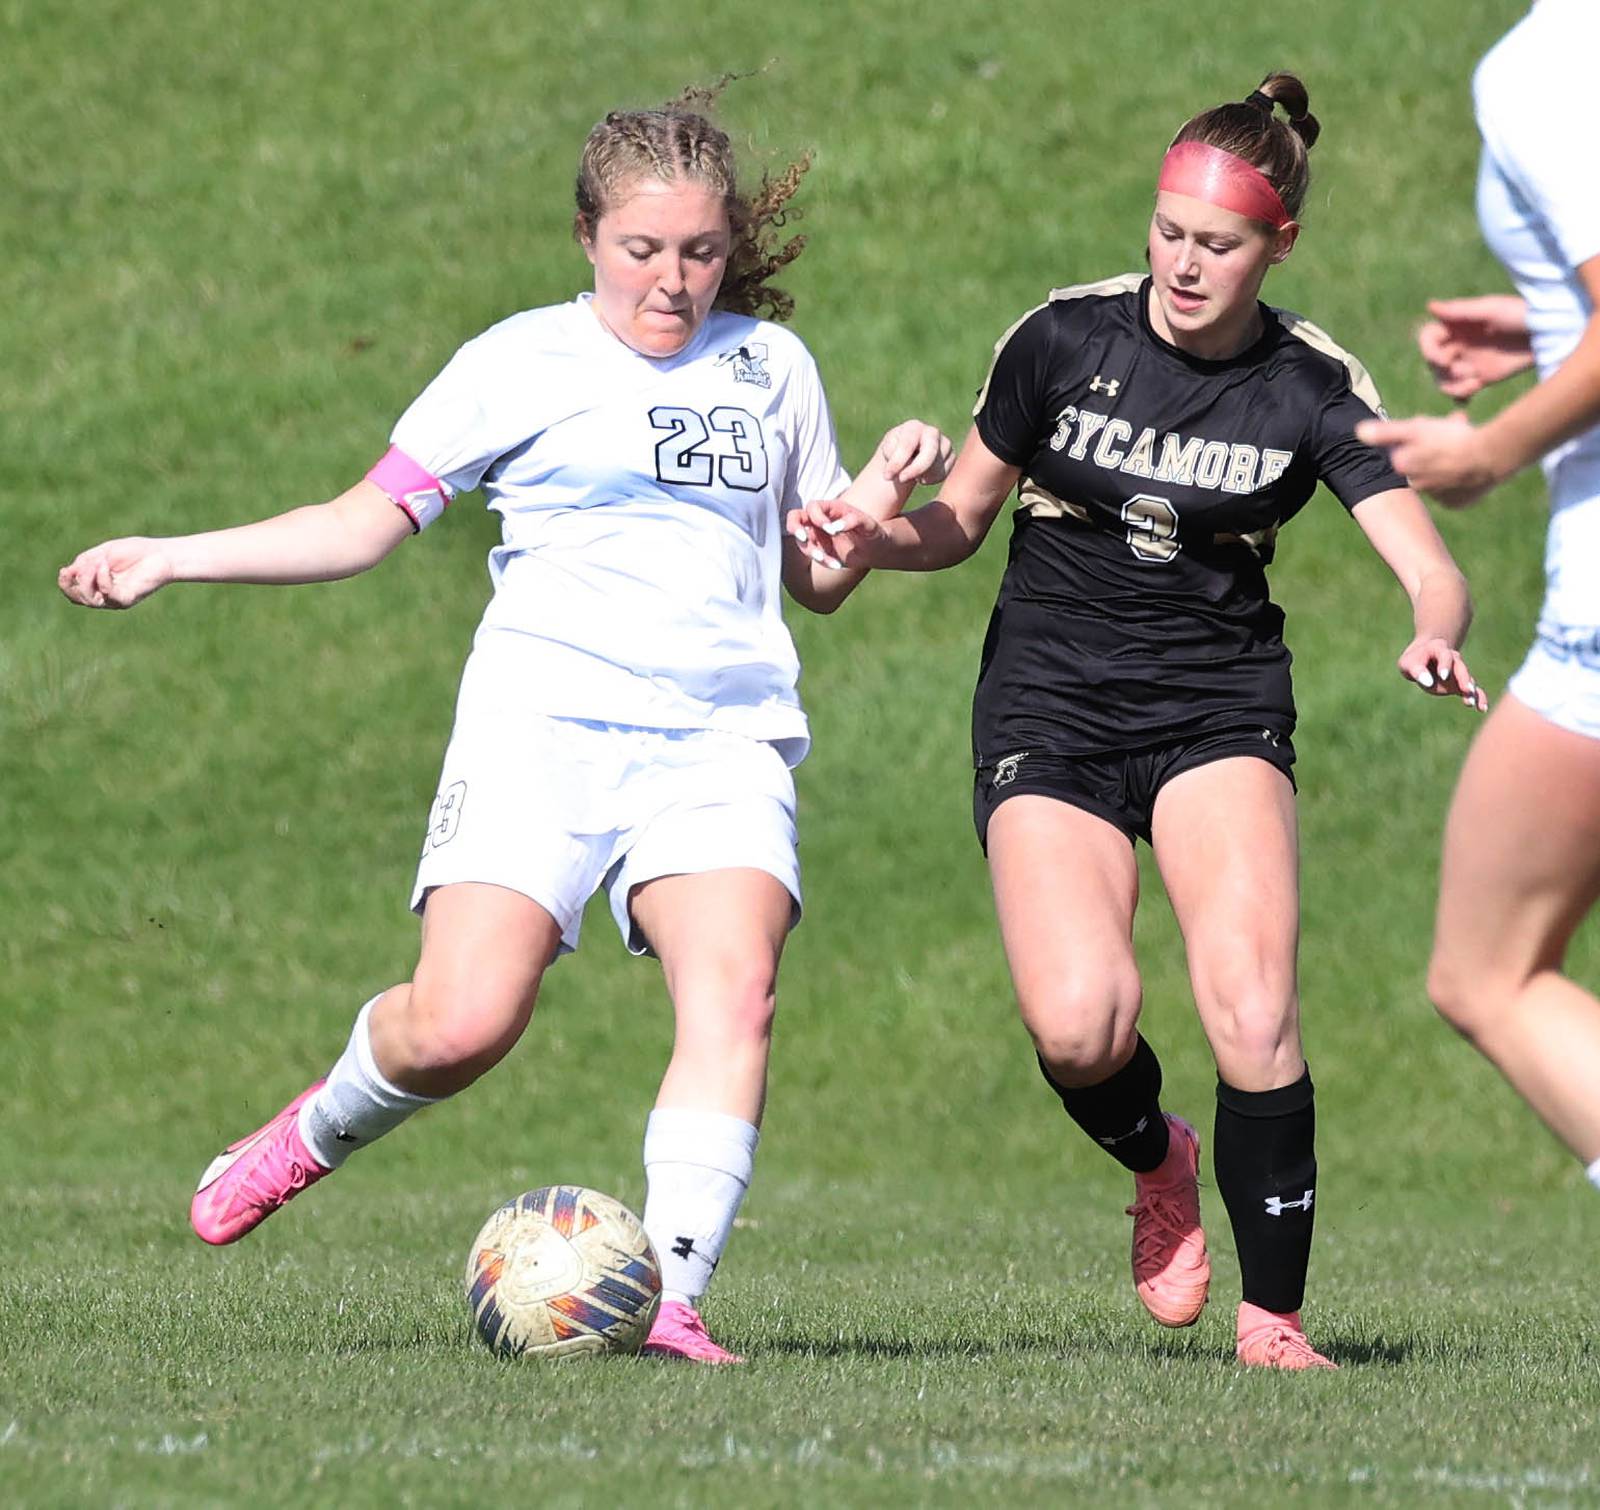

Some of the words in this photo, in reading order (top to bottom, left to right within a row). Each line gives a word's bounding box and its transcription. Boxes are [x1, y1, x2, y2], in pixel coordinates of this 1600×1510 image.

[648, 406, 769, 493] 23
[1050, 405, 1293, 494] SYCAMORE
[1121, 493, 1182, 562] 3
[420, 780, 467, 860] 3
